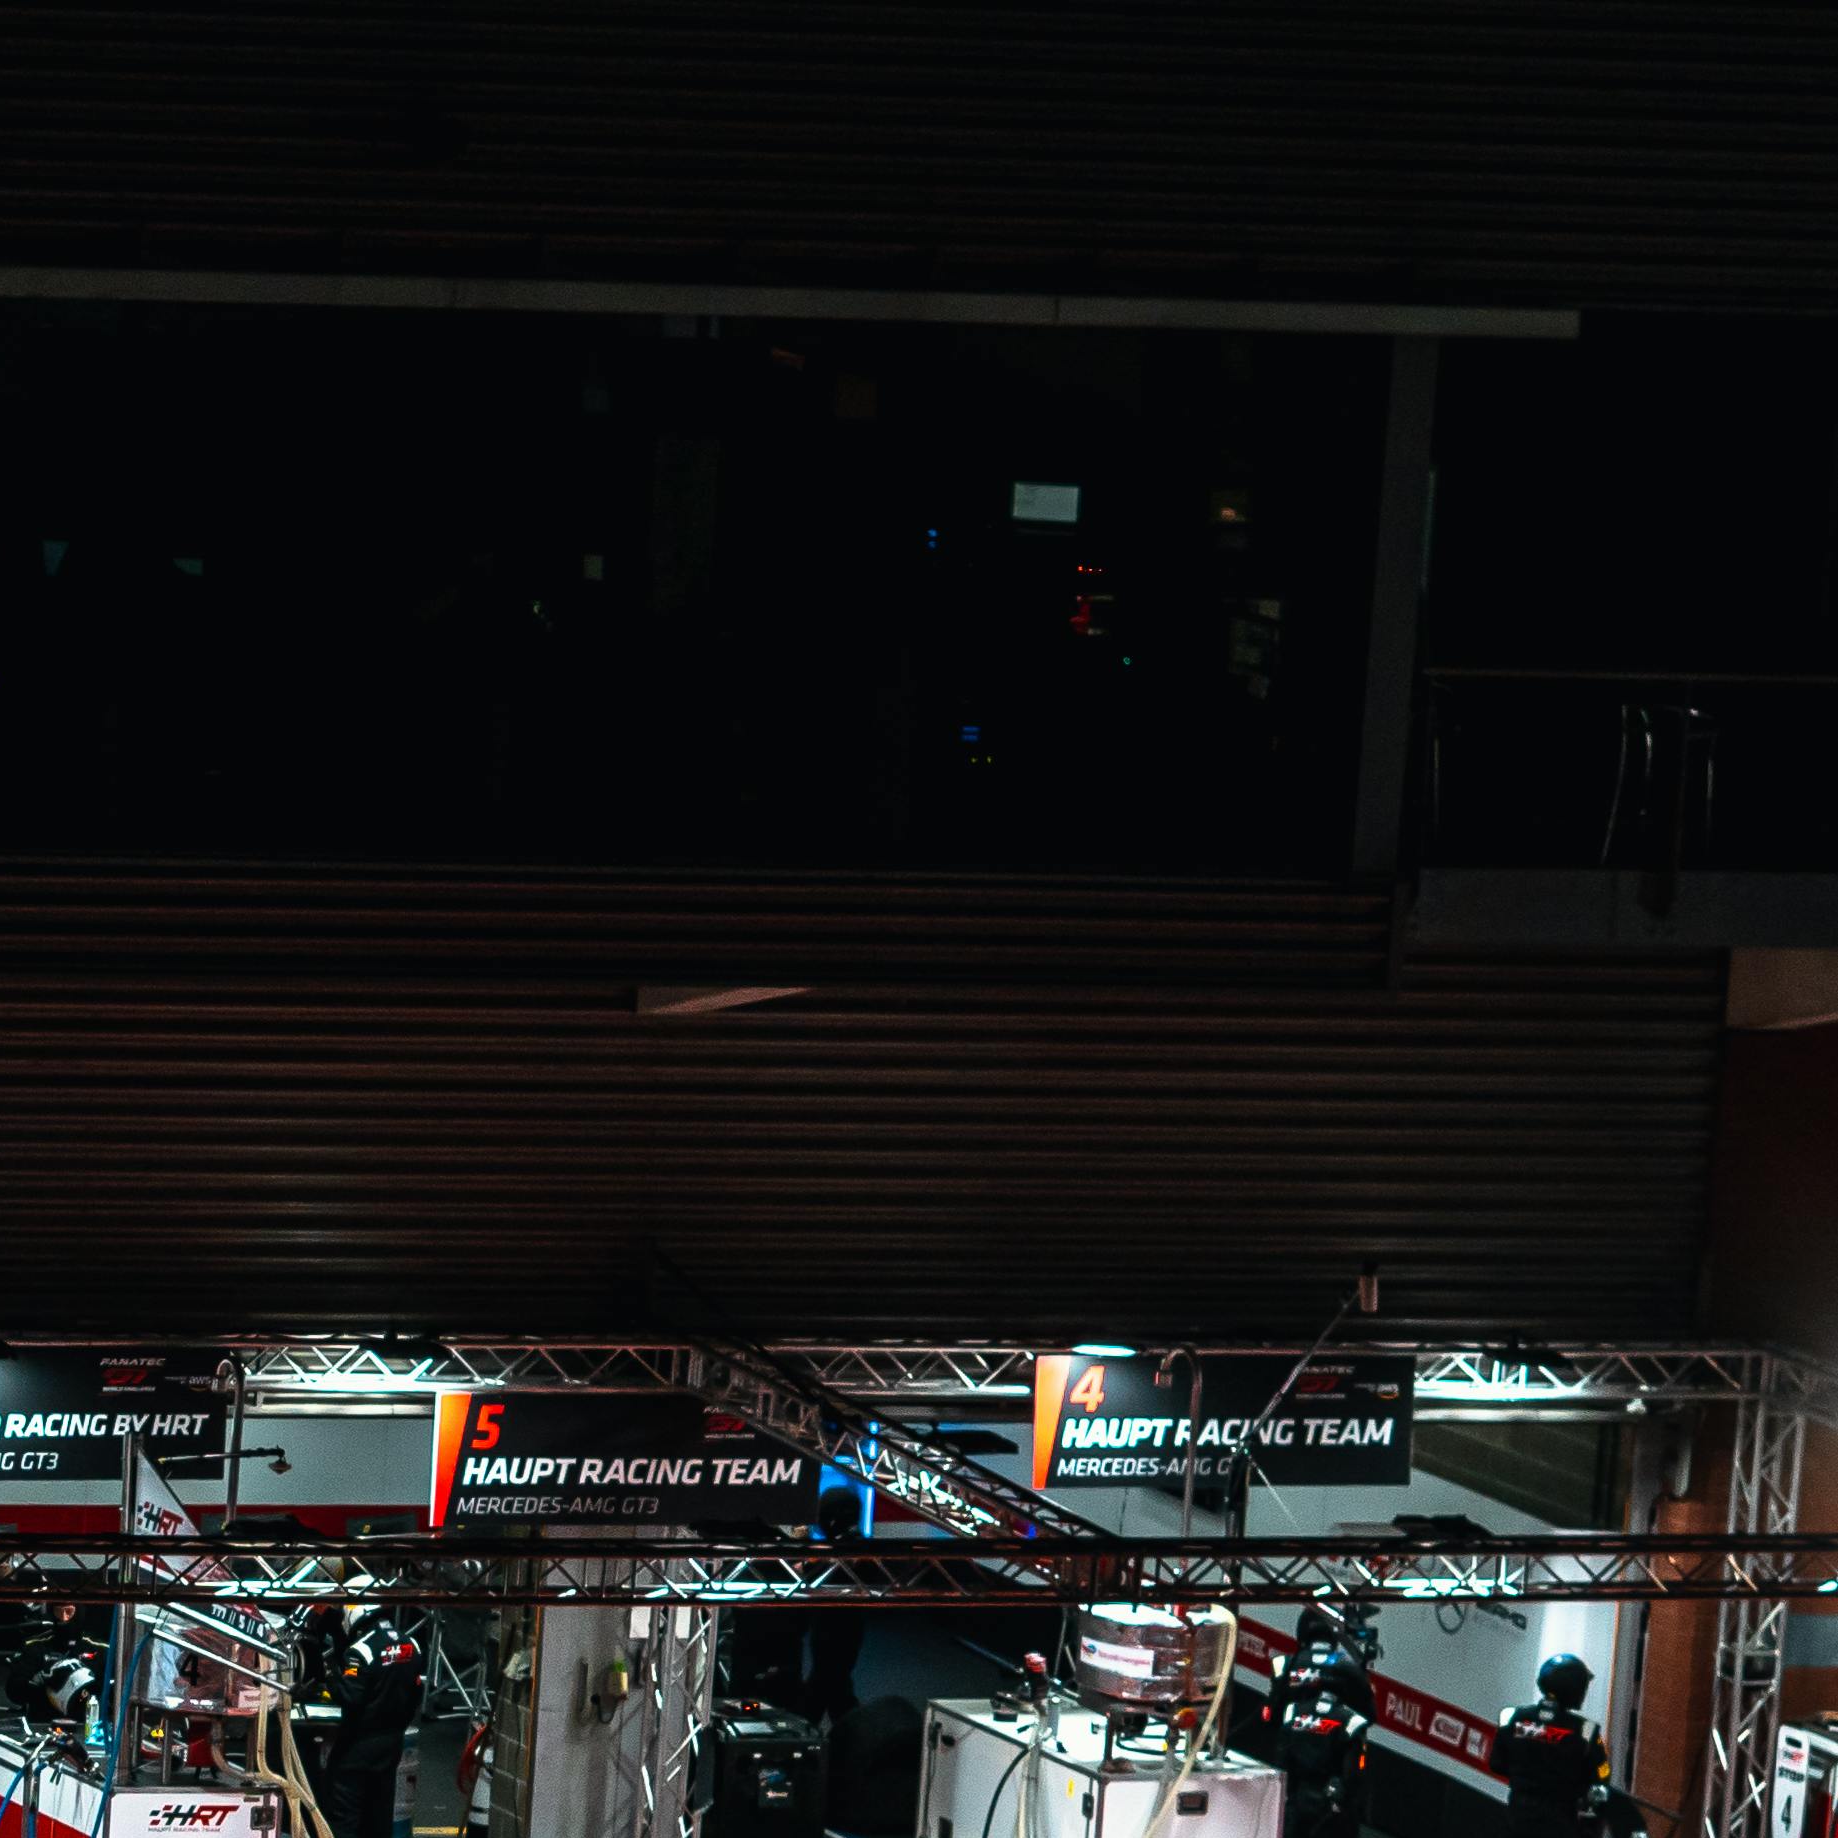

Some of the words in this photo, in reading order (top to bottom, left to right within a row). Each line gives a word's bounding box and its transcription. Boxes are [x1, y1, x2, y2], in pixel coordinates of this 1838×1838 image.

[100, 1358, 166, 1366] FANATEC
[1069, 1365, 1105, 1413] 4
[4, 1413, 107, 1438] RACING
[112, 1413, 151, 1436] BY
[151, 1413, 210, 1436] HRT
[471, 1403, 505, 1449] 5
[1062, 1417, 1175, 1448] HAUPT
[1301, 1417, 1394, 1446] TEAM
[20, 1451, 59, 1470] GT3
[462, 1457, 577, 1485] HAUPT
[579, 1458, 703, 1485] RACING
[710, 1458, 801, 1485] TEAM
[456, 1496, 615, 1515] MERCEDES-AMG
[621, 1496, 660, 1515] GT3
[162, 1805, 240, 1826] HRT
